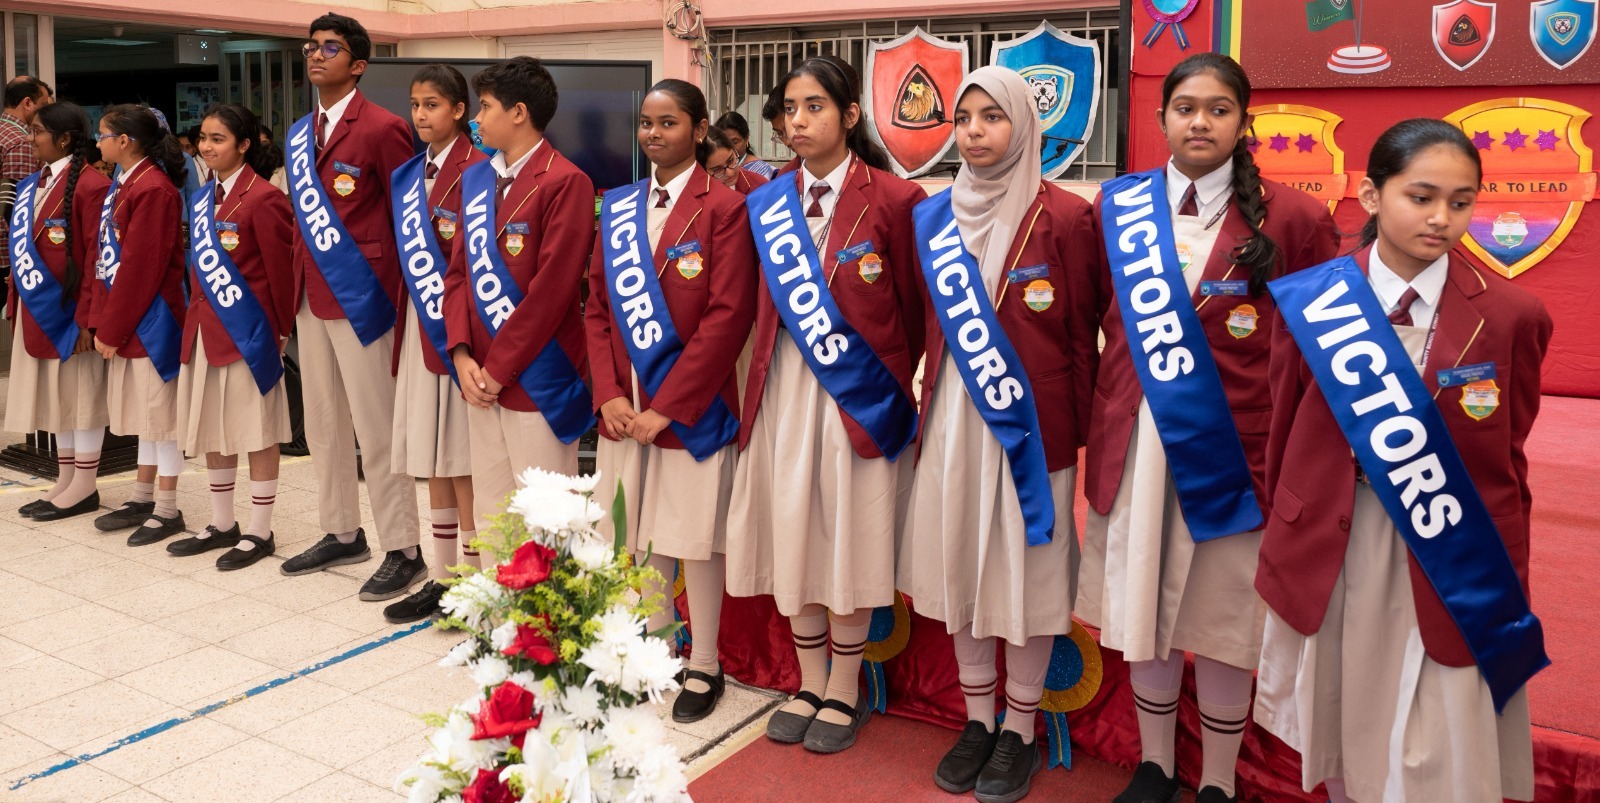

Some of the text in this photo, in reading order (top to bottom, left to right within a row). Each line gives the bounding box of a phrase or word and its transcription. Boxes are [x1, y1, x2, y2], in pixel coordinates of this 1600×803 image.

[13, 183, 44, 291] VICTORS
[194, 190, 243, 308] VICTORS
[291, 123, 341, 251] VICTORS
[402, 178, 445, 320] VICTORS
[1506, 182, 1525, 193] TO
[1530, 182, 1568, 193] LEAD
[610, 189, 663, 350] VICTORS
[760, 194, 849, 365] VICTORS
[929, 218, 1024, 410] VICTORS
[1114, 178, 1195, 382] VICTORS
[1302, 279, 1463, 539] VICTORS
